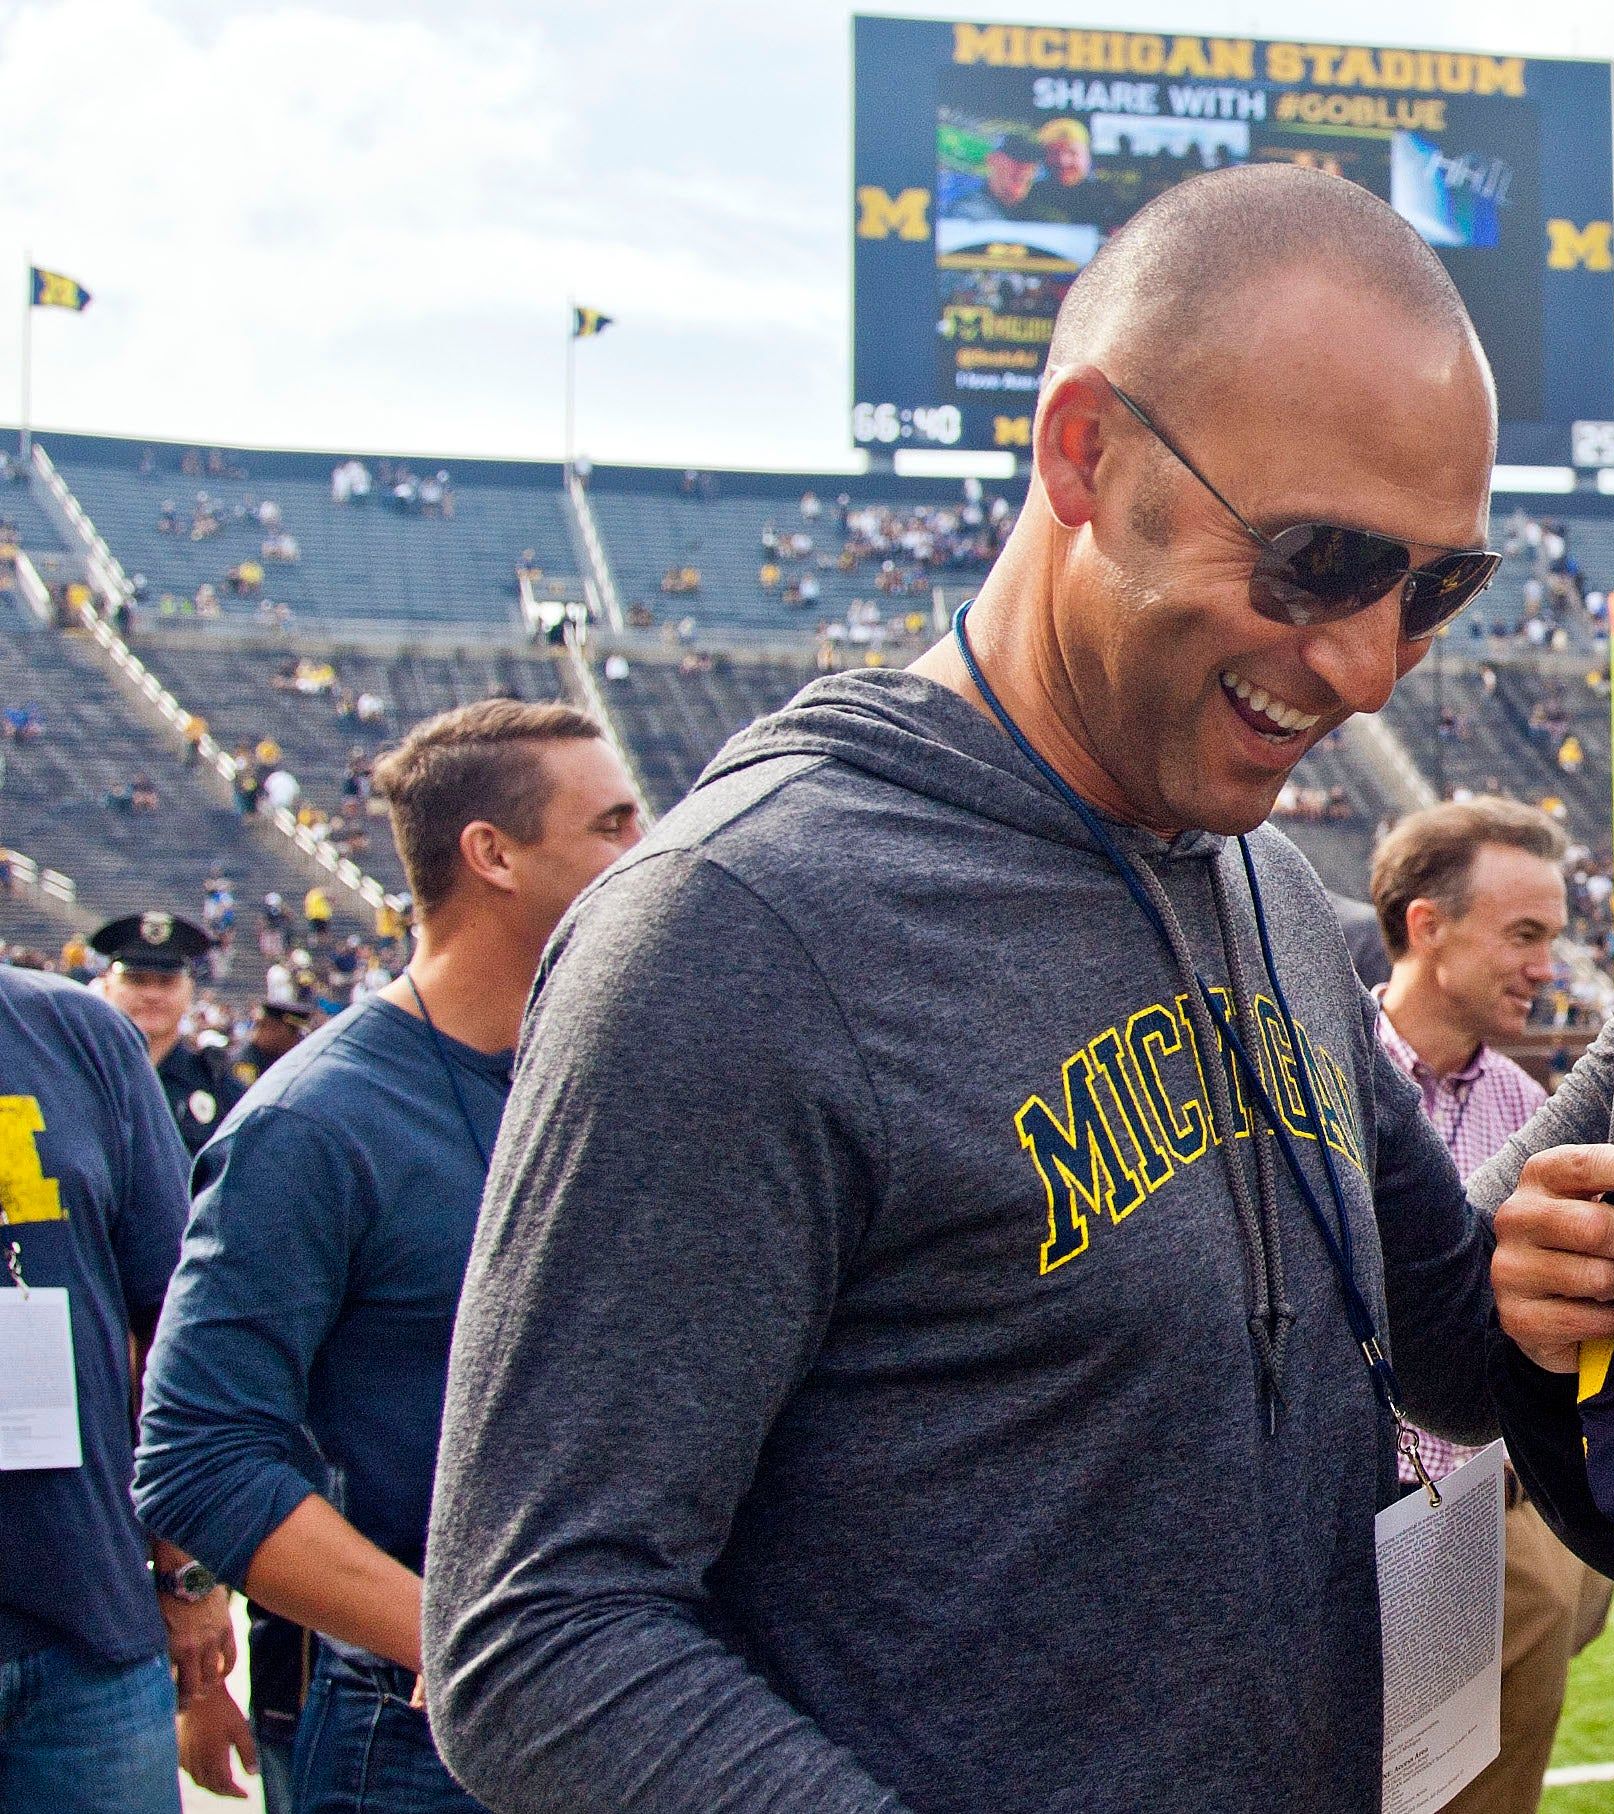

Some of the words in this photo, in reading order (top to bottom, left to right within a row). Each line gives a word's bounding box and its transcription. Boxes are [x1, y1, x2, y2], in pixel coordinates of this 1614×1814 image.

[953, 22, 1254, 79] MICHIGAN
[1266, 41, 1526, 97] STADIUM
[1032, 77, 1160, 115] SHARE
[1167, 83, 1267, 121] WITH
[1276, 91, 1448, 132] #GOBLUE
[857, 186, 932, 242] M
[1546, 218, 1614, 272] M
[854, 402, 962, 445] 66:40
[1013, 986, 1370, 1276] MICHGAN
